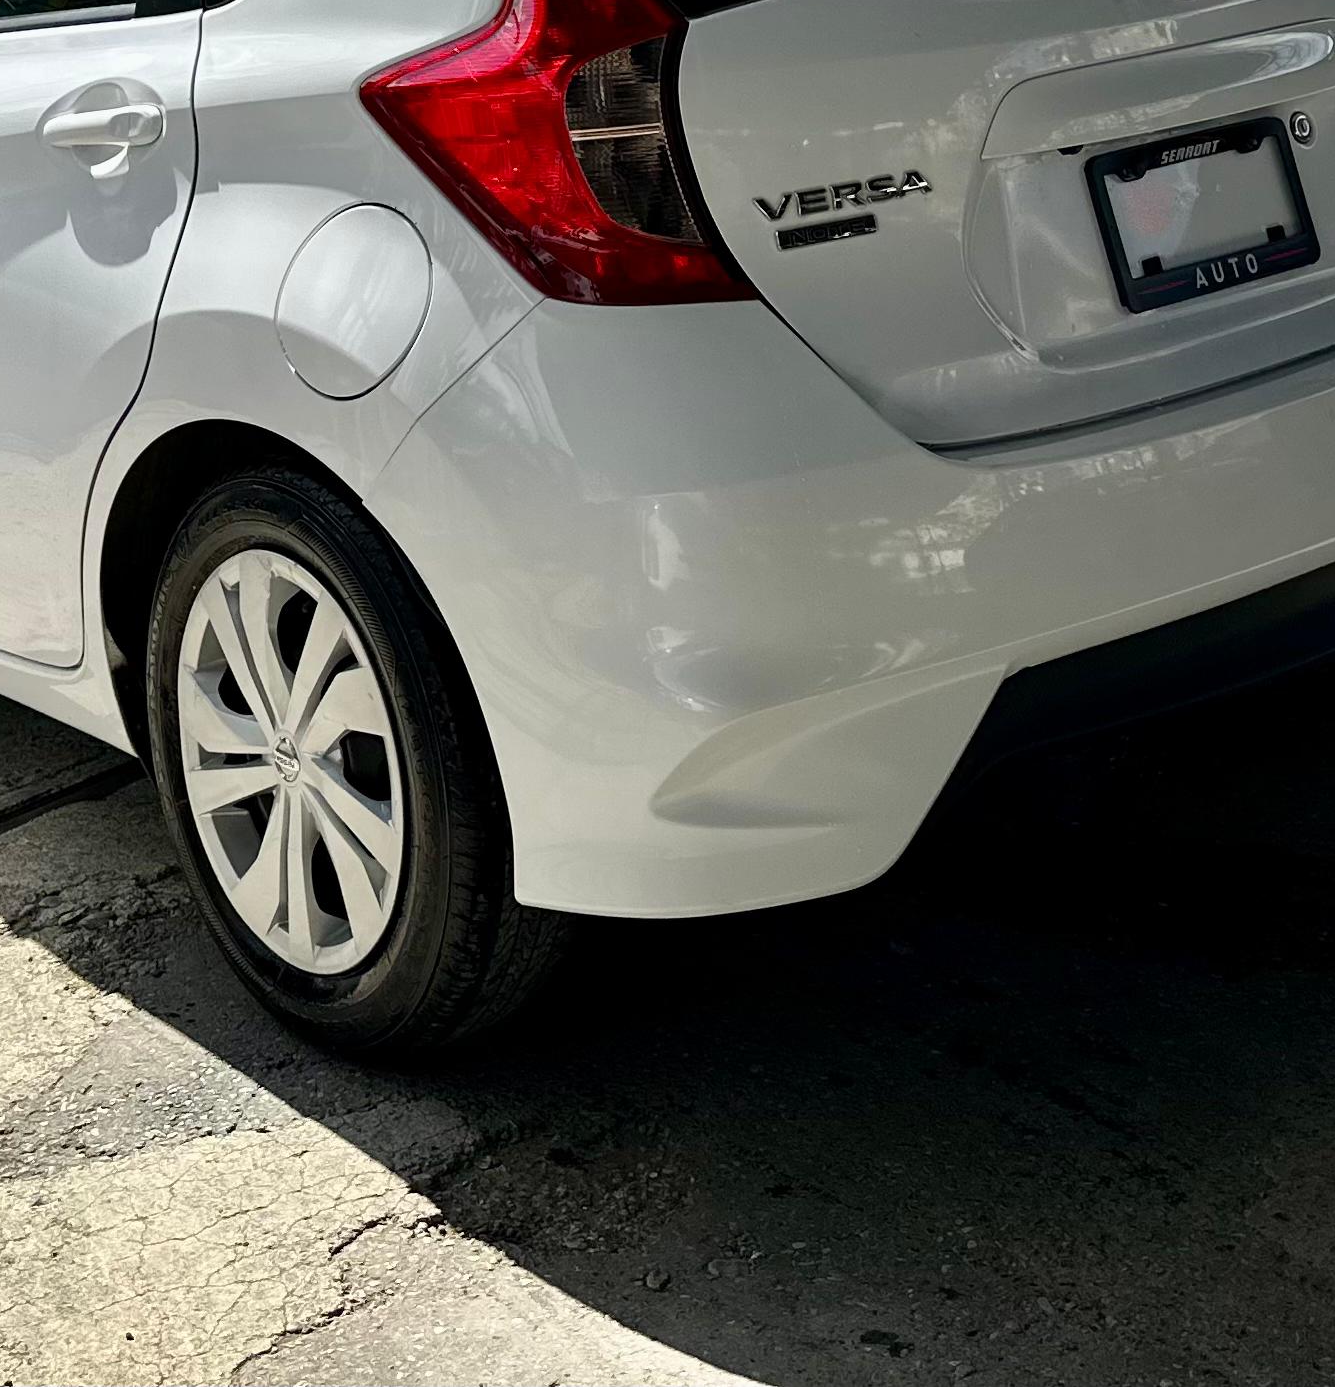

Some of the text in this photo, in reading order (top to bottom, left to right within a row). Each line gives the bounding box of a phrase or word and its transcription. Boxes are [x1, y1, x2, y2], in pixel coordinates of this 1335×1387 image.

[752, 169, 933, 223] VERSA
[789, 220, 866, 247] NOTE
[1195, 253, 1259, 289] AUTO
